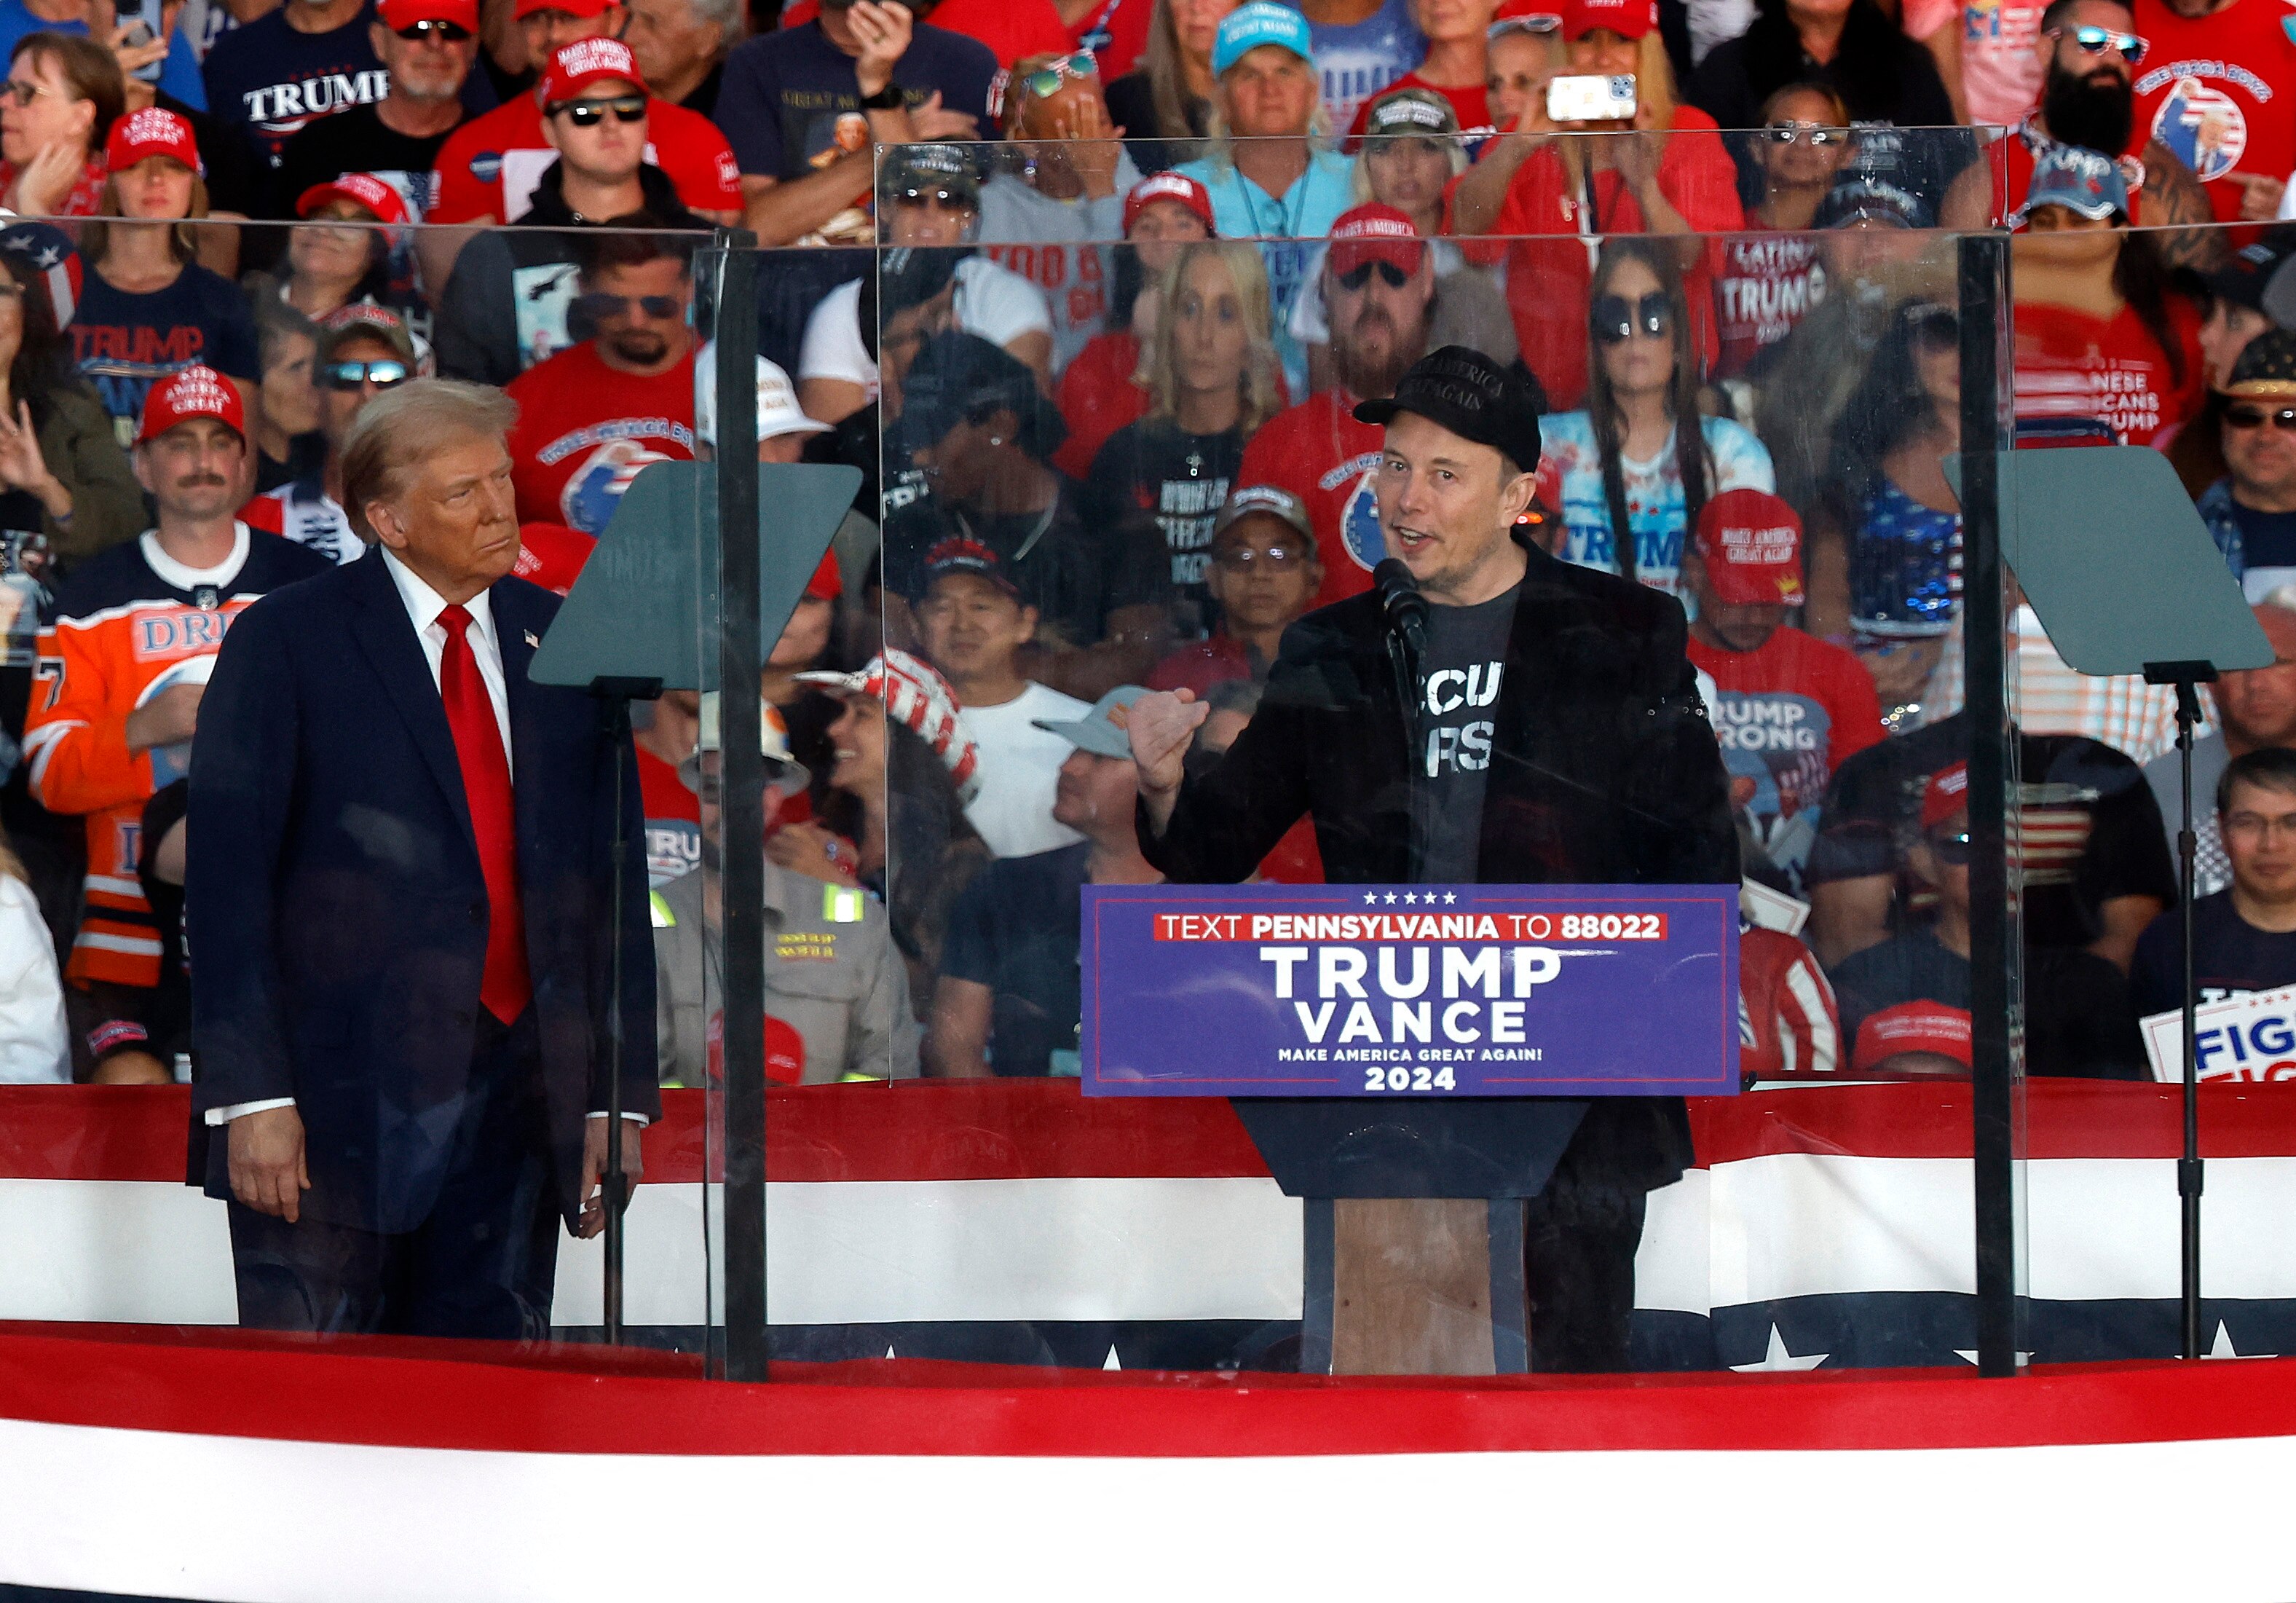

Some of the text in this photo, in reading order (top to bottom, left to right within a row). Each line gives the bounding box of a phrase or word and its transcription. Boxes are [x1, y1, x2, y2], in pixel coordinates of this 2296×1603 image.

[1735, 237, 1816, 274] LATIN
[1722, 275, 1807, 323] TRUM
[68, 323, 205, 364] TRUMP
[2100, 392, 2160, 412] CANS
[142, 610, 239, 653] DRI
[1416, 661, 1504, 717] CU
[1161, 915, 1660, 940] TEXT PENNSYLVANIA TO 88022
[1260, 947, 1562, 999] TRUMP
[1294, 1001, 1526, 1044] VANCE
[2195, 1017, 2296, 1070] FIG
[1278, 1048, 1543, 1062] MAKE AMERICA GREAT AGAIN!
[1365, 1066, 1457, 1092] 2024
